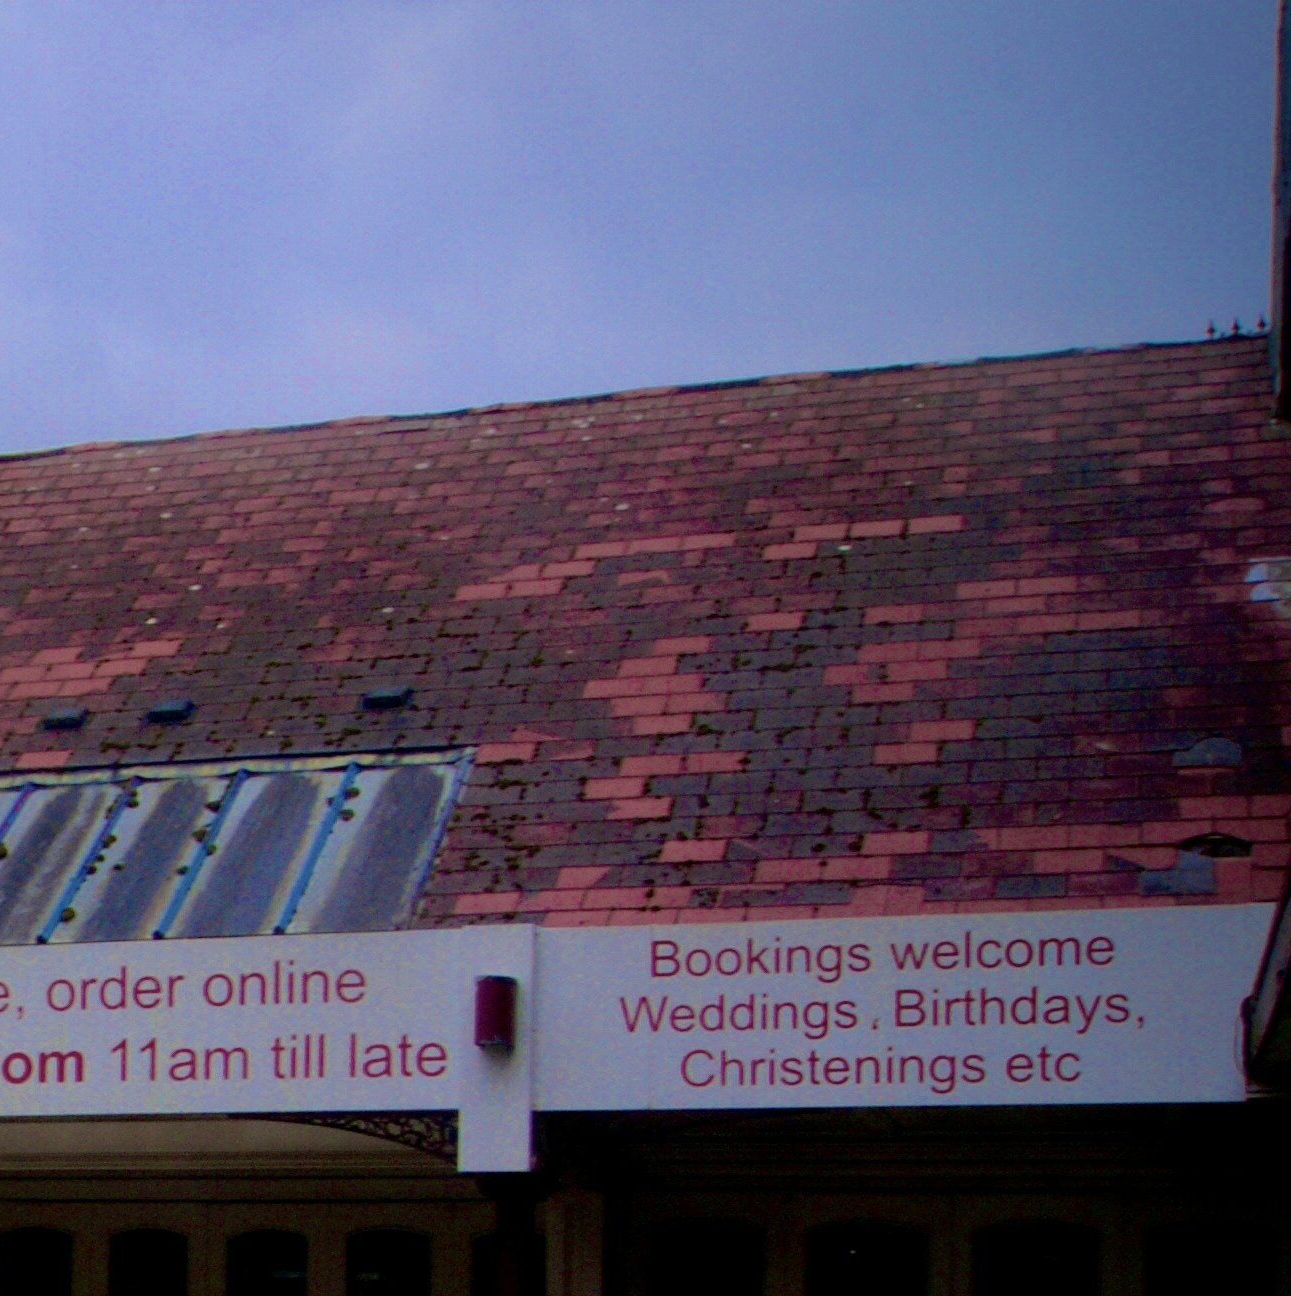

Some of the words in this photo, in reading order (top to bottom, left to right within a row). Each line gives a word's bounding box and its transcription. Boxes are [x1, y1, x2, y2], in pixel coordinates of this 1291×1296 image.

[649, 936, 873, 984] Bookings
[890, 930, 1116, 971] welcome
[45, 964, 183, 1013] order
[201, 958, 368, 1009] online
[894, 985, 1147, 1034] Birthdays,
[109, 1036, 249, 1085] 11am
[270, 1032, 328, 1082] till
[347, 1031, 450, 1079] late
[679, 1046, 987, 1095] Christenings
[1005, 1045, 1084, 1085] etc
